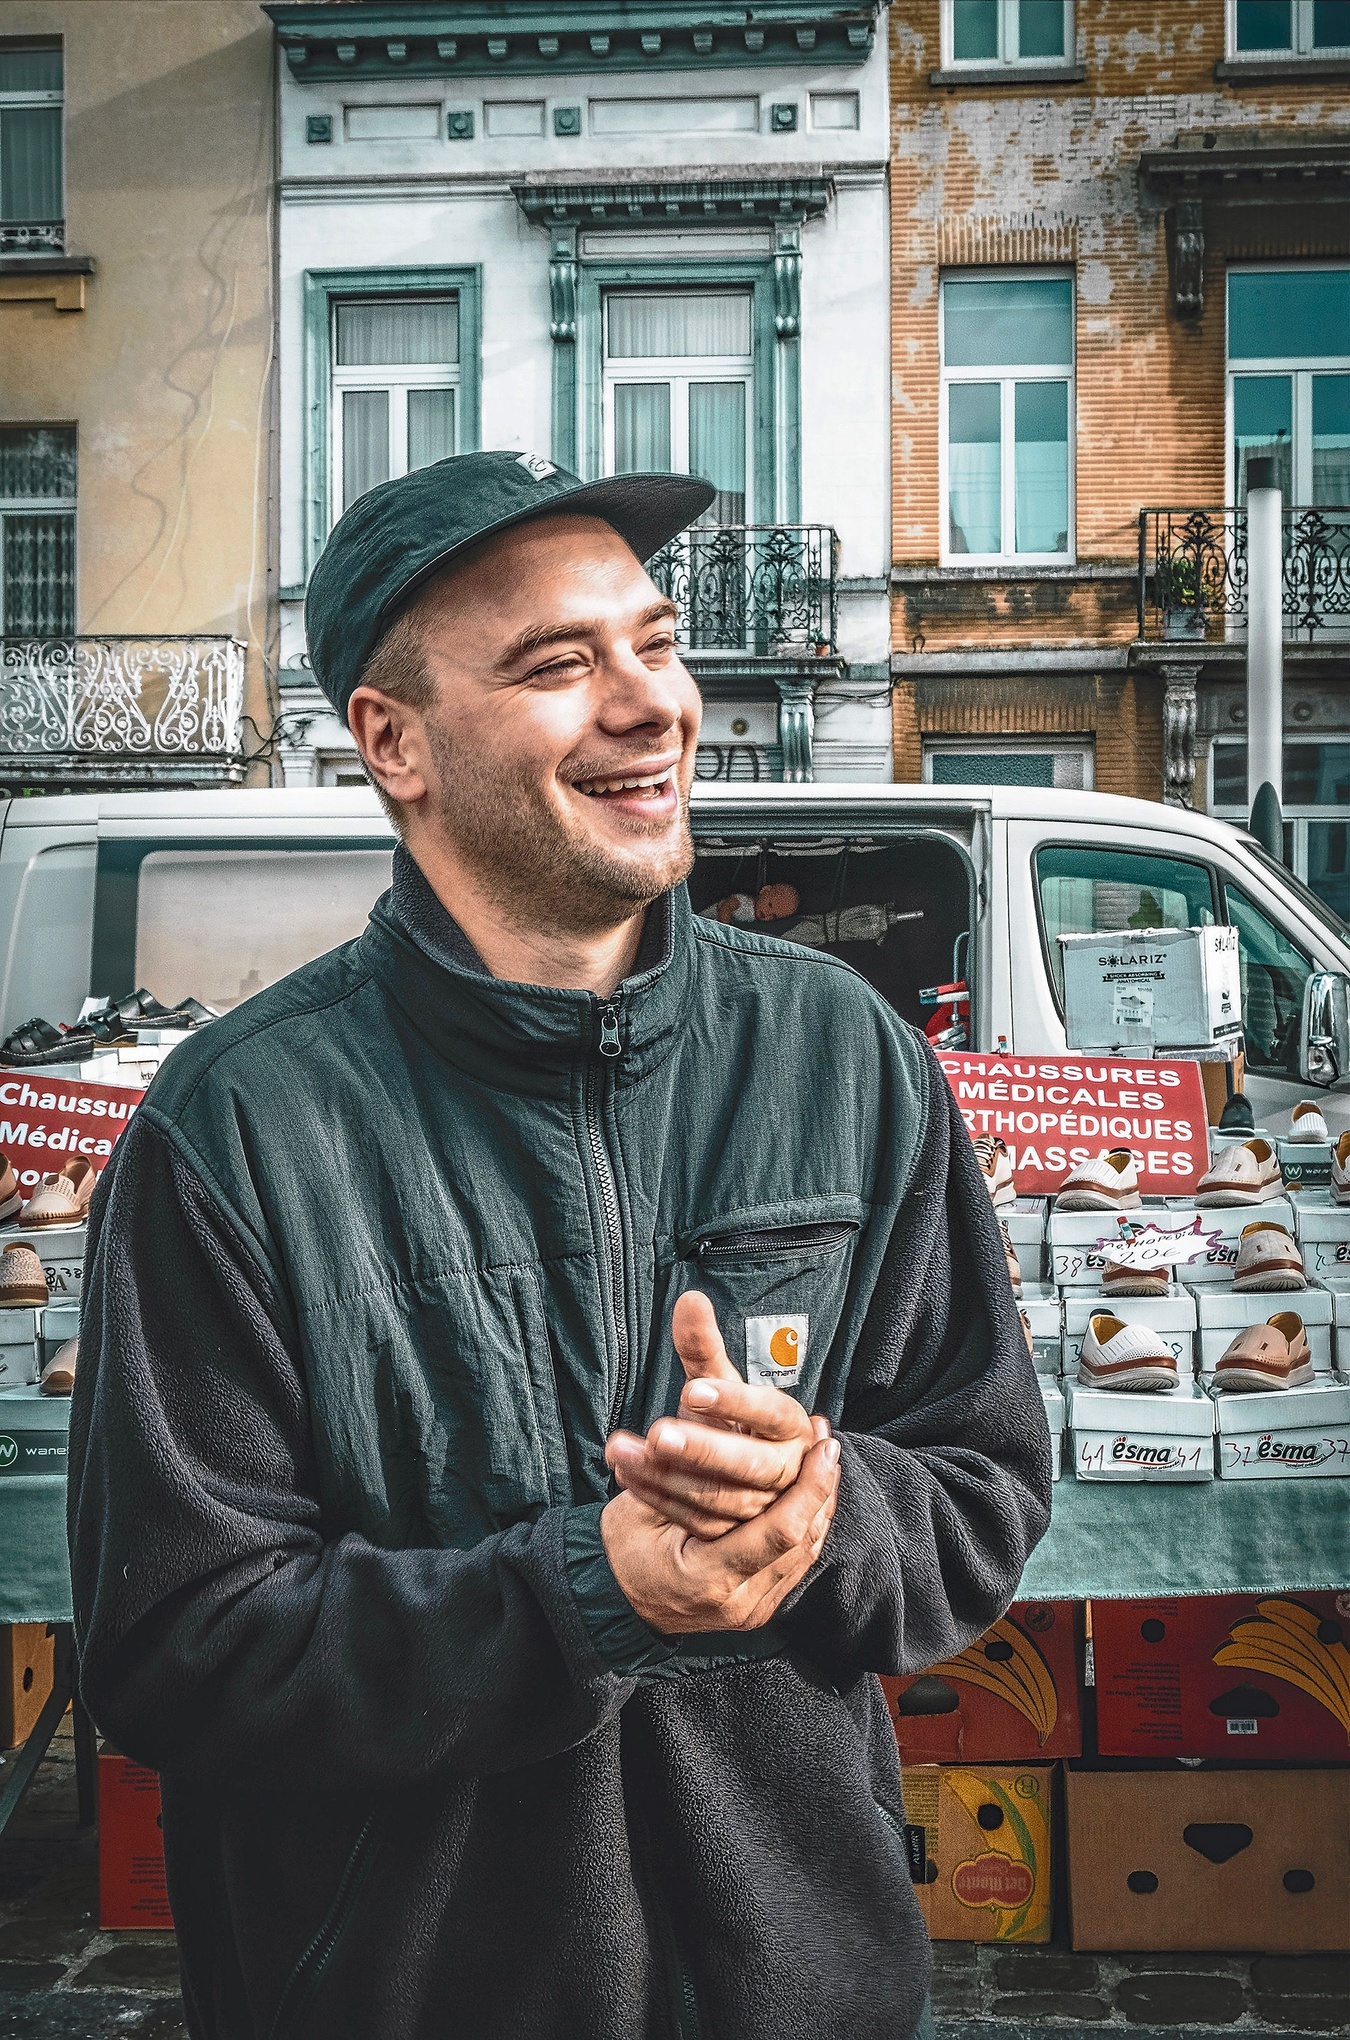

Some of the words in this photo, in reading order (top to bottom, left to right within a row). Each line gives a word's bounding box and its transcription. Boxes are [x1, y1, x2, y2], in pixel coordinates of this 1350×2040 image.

[943, 1060, 1181, 1087] CHAUSSURES
[958, 1079, 1165, 1110] MÉDICALES
[961, 1109, 1193, 1142] RTHOPÉDIQUES
[25, 1447, 69, 1455] wane
[1112, 1441, 1171, 1463] esma
[1258, 1440, 1318, 1461] esma
